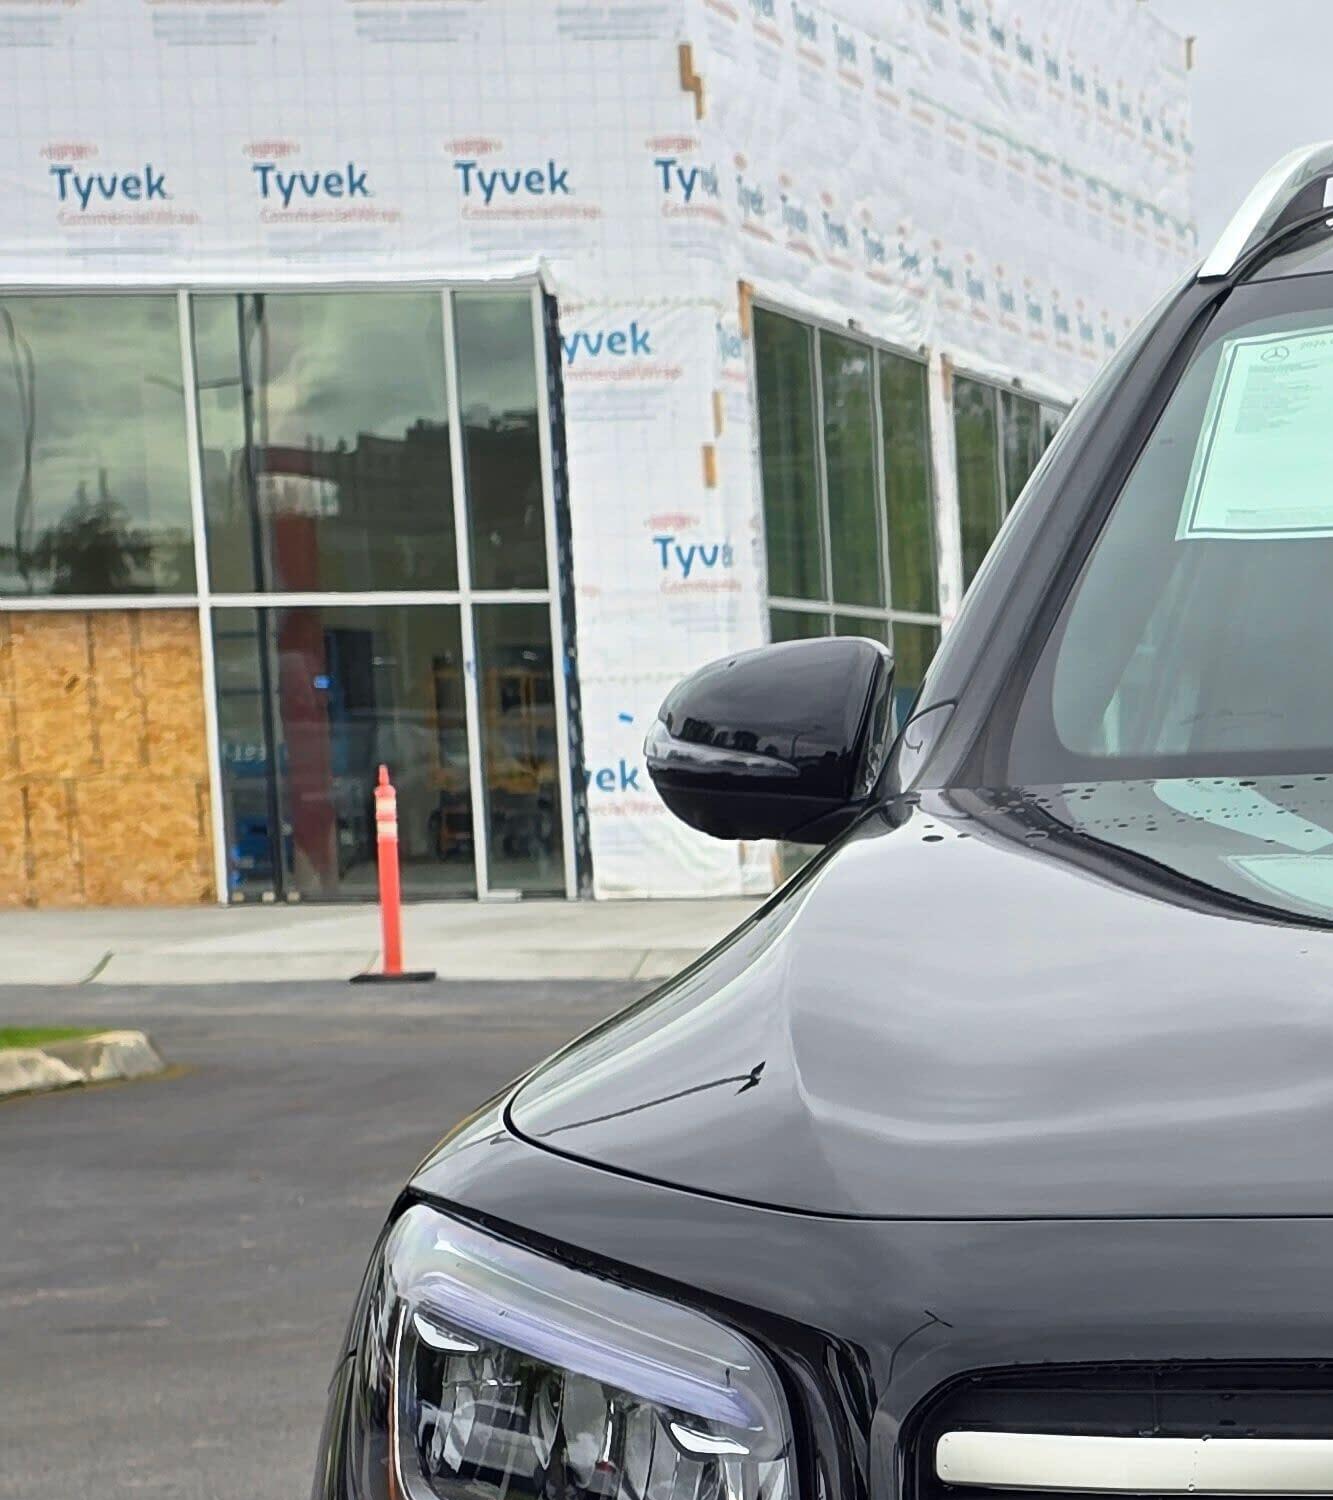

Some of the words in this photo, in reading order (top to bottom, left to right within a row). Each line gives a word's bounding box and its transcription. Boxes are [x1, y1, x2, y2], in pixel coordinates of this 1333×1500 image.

[49, 162, 168, 210] Tyvek
[252, 161, 370, 208] Tyvek
[453, 158, 570, 205] Tyvek
[560, 320, 651, 365] yvek
